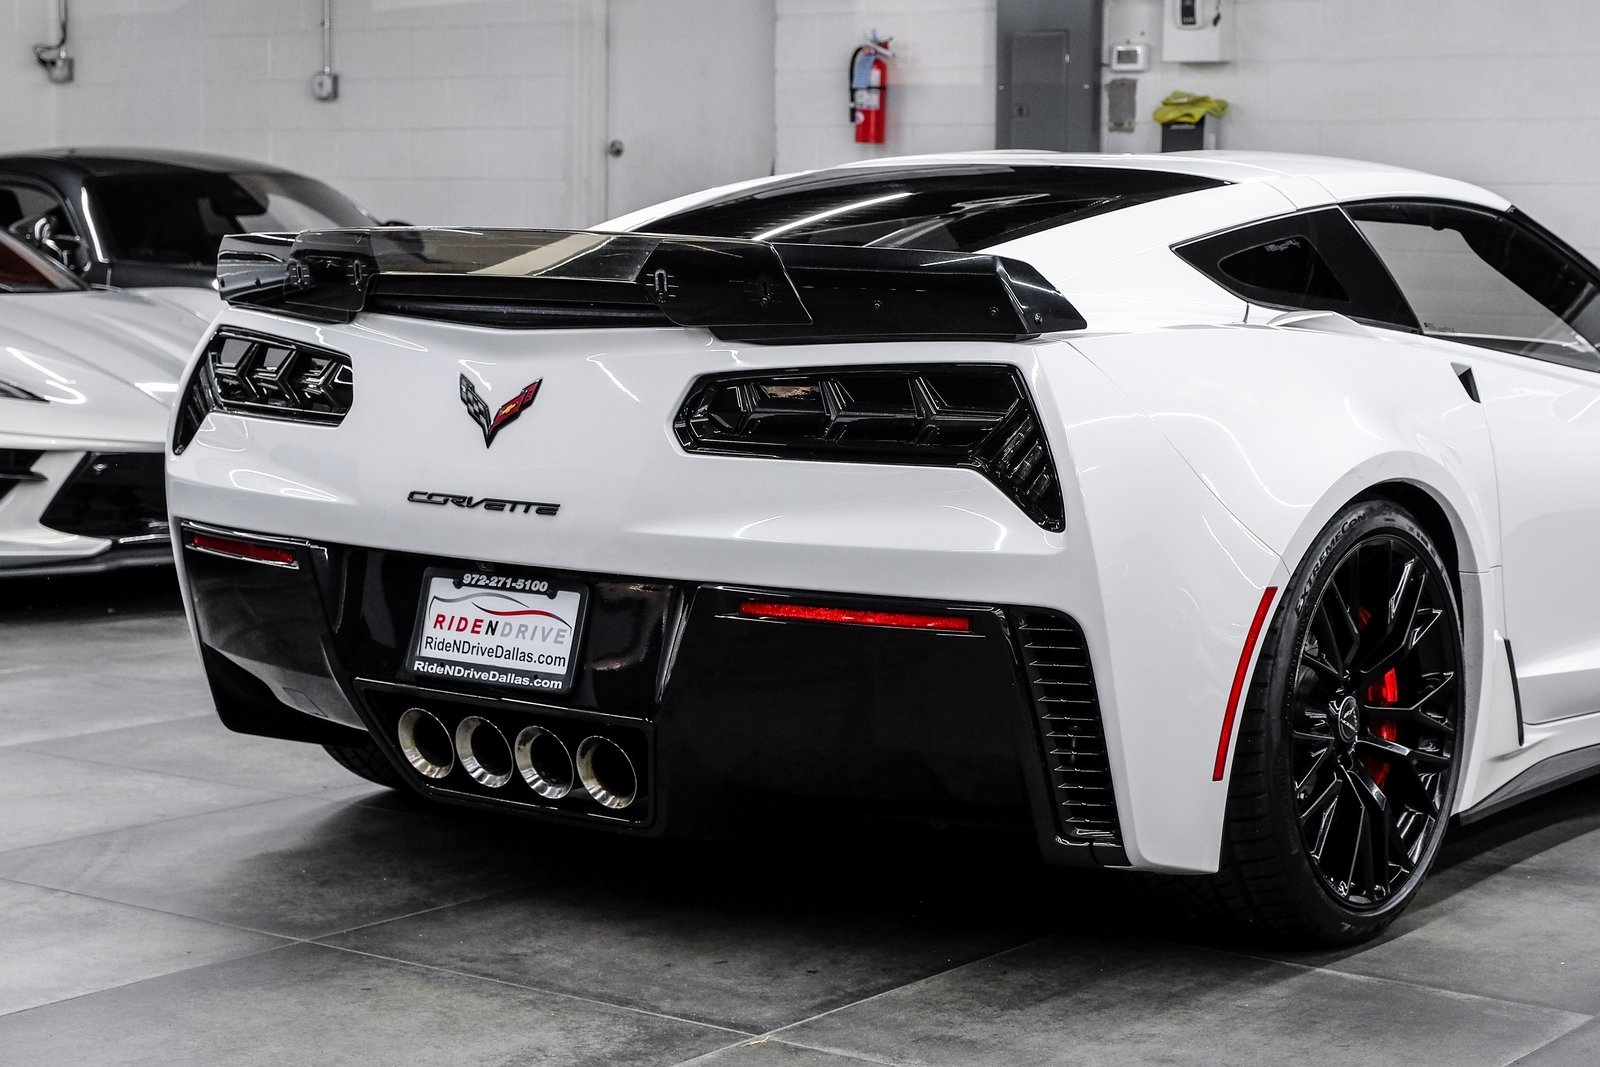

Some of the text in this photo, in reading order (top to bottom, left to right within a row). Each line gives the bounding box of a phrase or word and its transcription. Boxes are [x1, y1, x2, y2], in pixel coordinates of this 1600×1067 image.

[407, 490, 561, 516] CORVETTE
[462, 573, 549, 592] 972-271-5100
[424, 636, 566, 667] RideNDriveDallas.com
[413, 660, 563, 689] RideNDriveDallas.com
